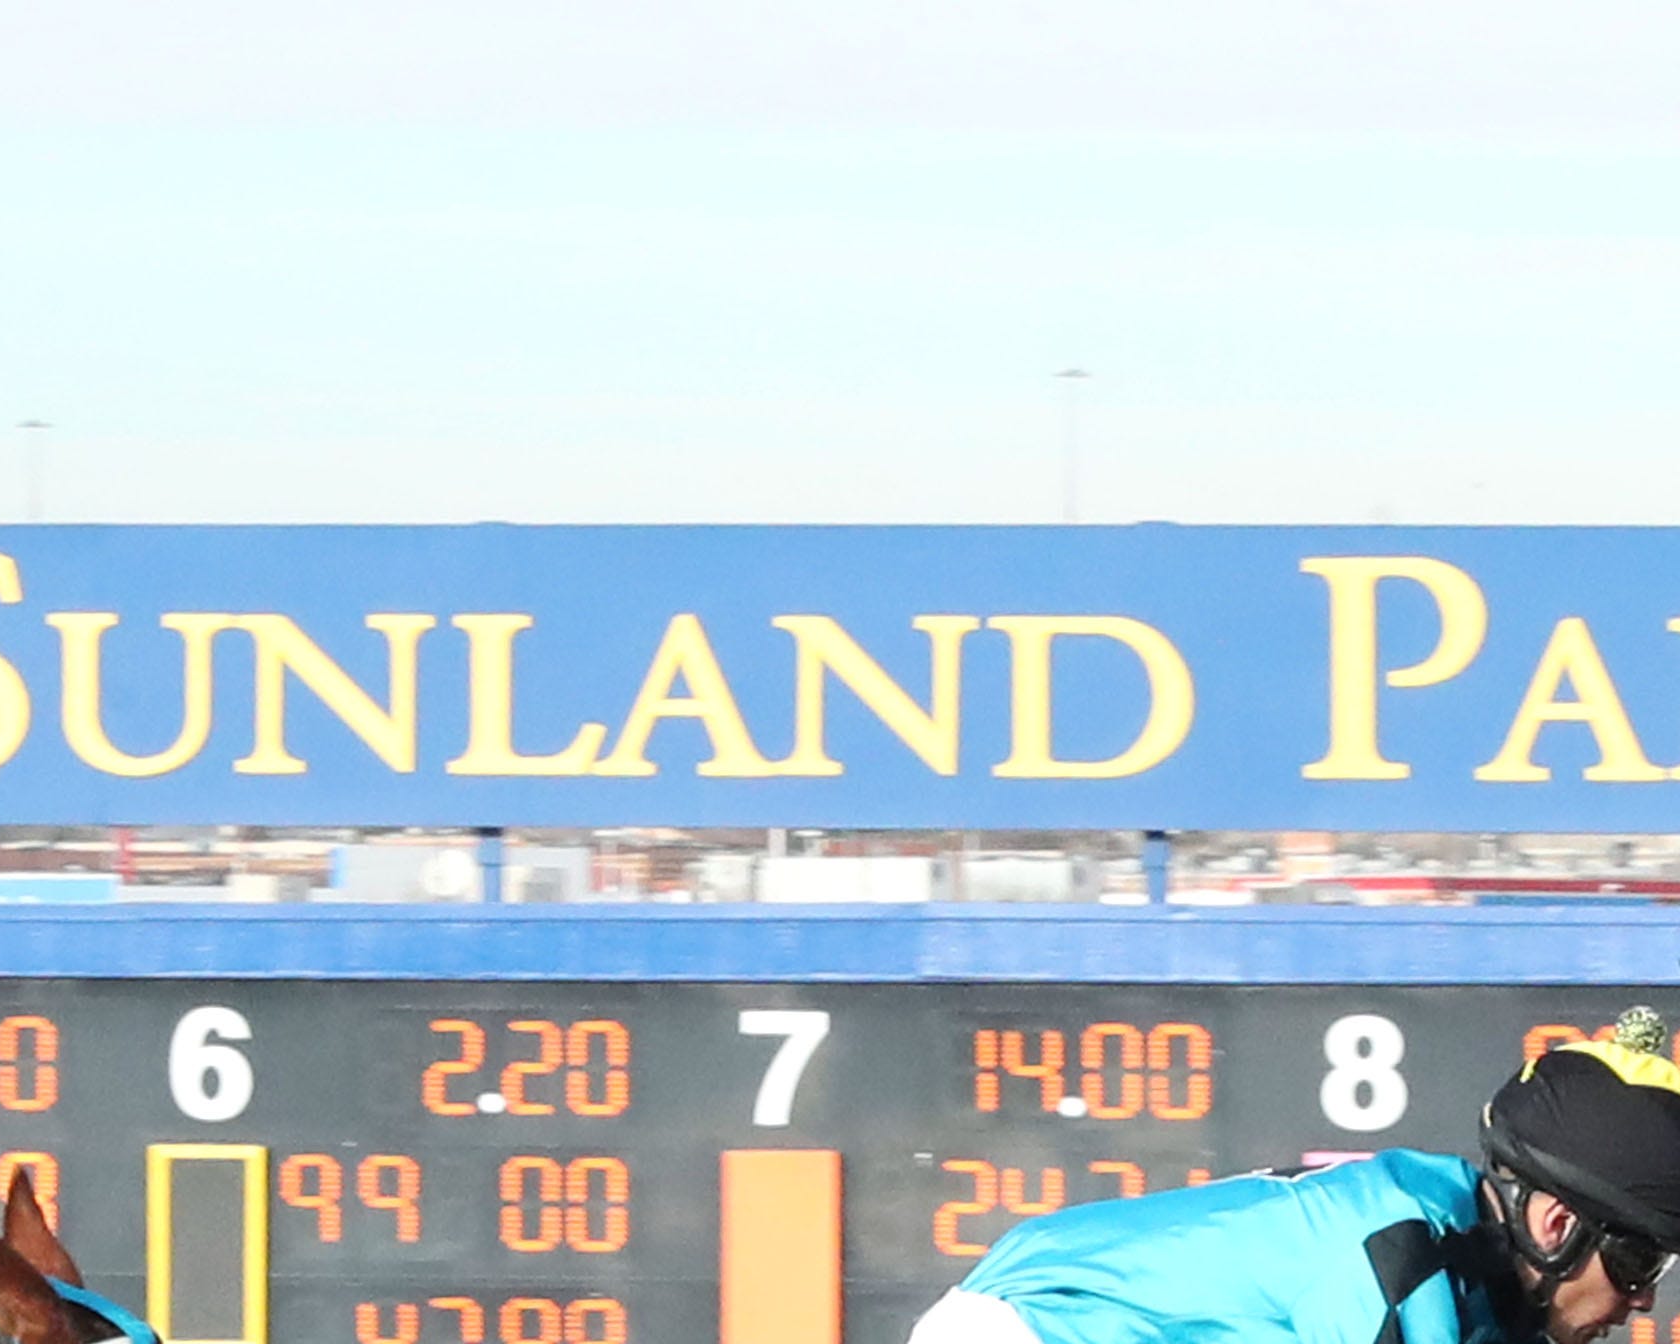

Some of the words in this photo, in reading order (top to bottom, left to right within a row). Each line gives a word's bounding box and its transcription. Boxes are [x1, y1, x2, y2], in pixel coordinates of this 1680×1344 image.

[168, 1005, 254, 1122] 6
[420, 1018, 631, 1118] 2.20
[737, 1009, 831, 1128] 7
[974, 1021, 1213, 1121] 14.00
[1319, 1013, 1409, 1132] 8
